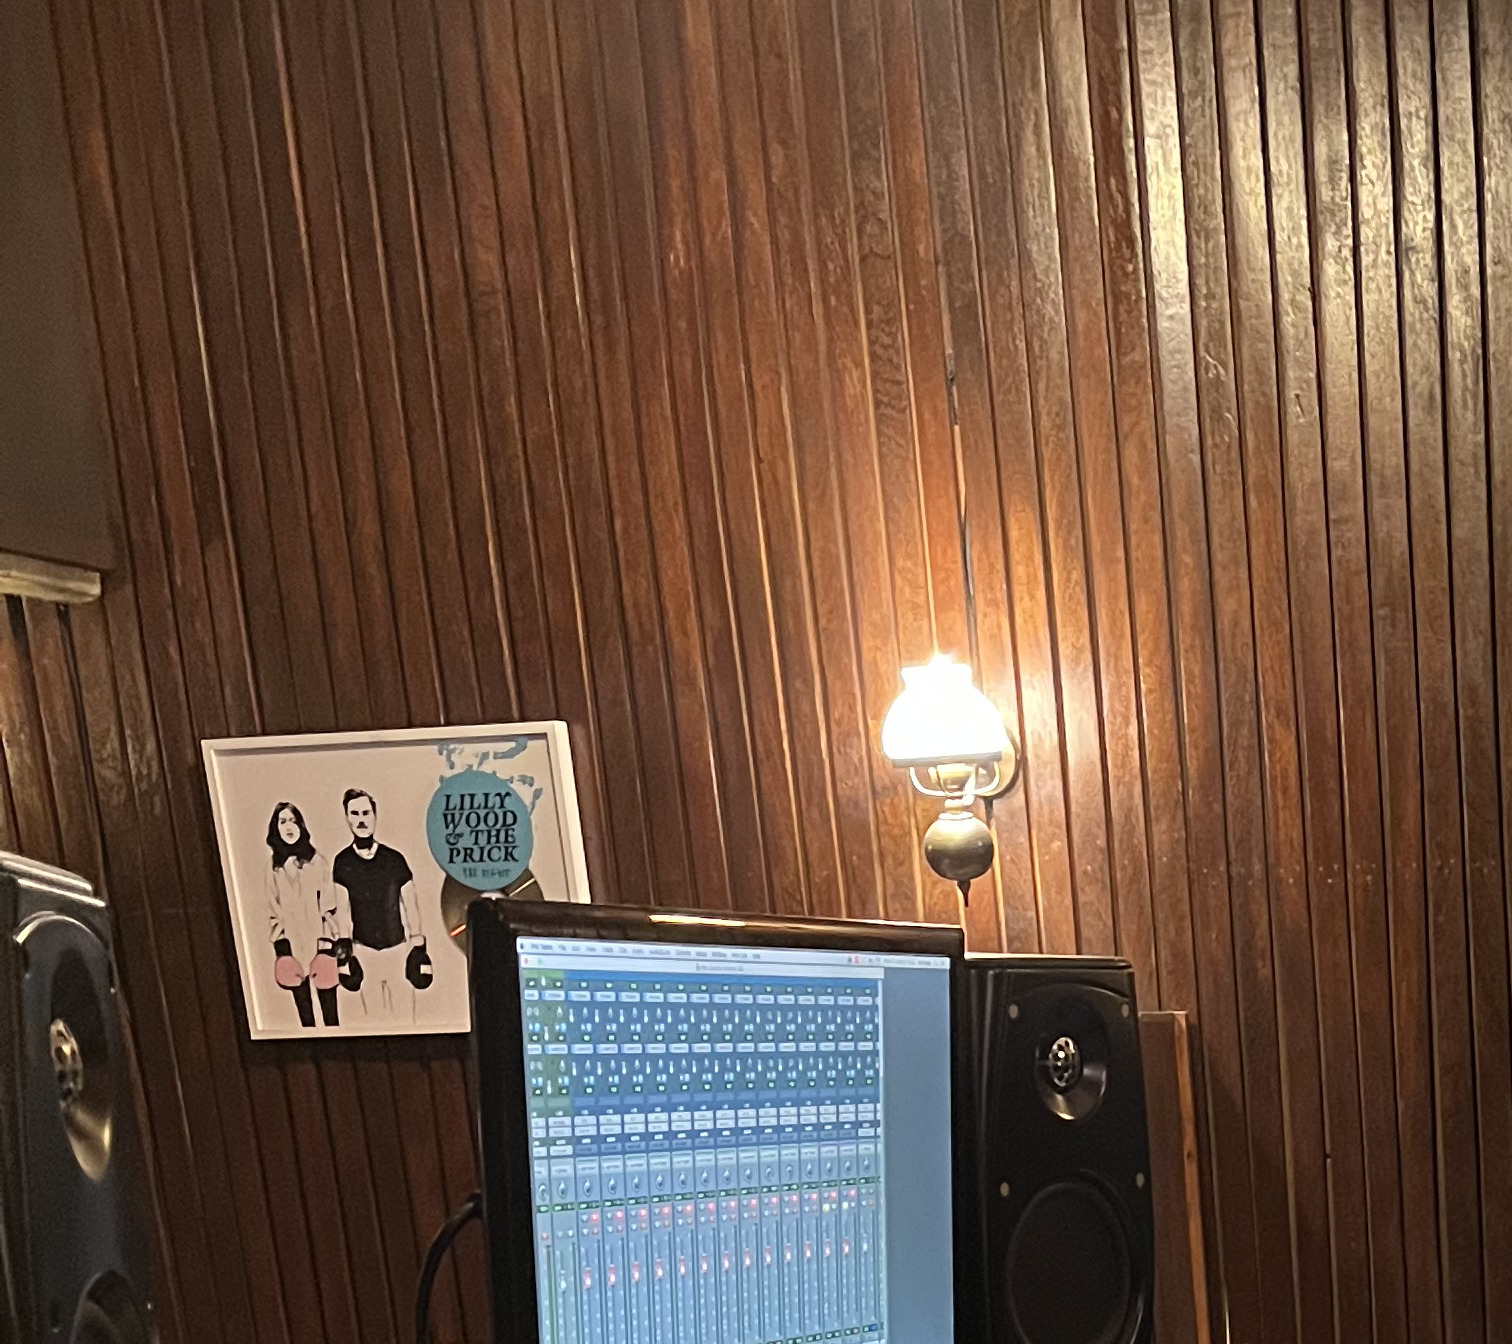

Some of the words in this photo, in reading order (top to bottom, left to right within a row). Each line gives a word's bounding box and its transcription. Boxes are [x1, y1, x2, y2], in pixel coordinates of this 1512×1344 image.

[444, 791, 512, 811] LILLY
[442, 810, 518, 831] WOOD
[445, 832, 464, 846] &
[469, 828, 516, 846] THE
[448, 845, 519, 865] PRICK
